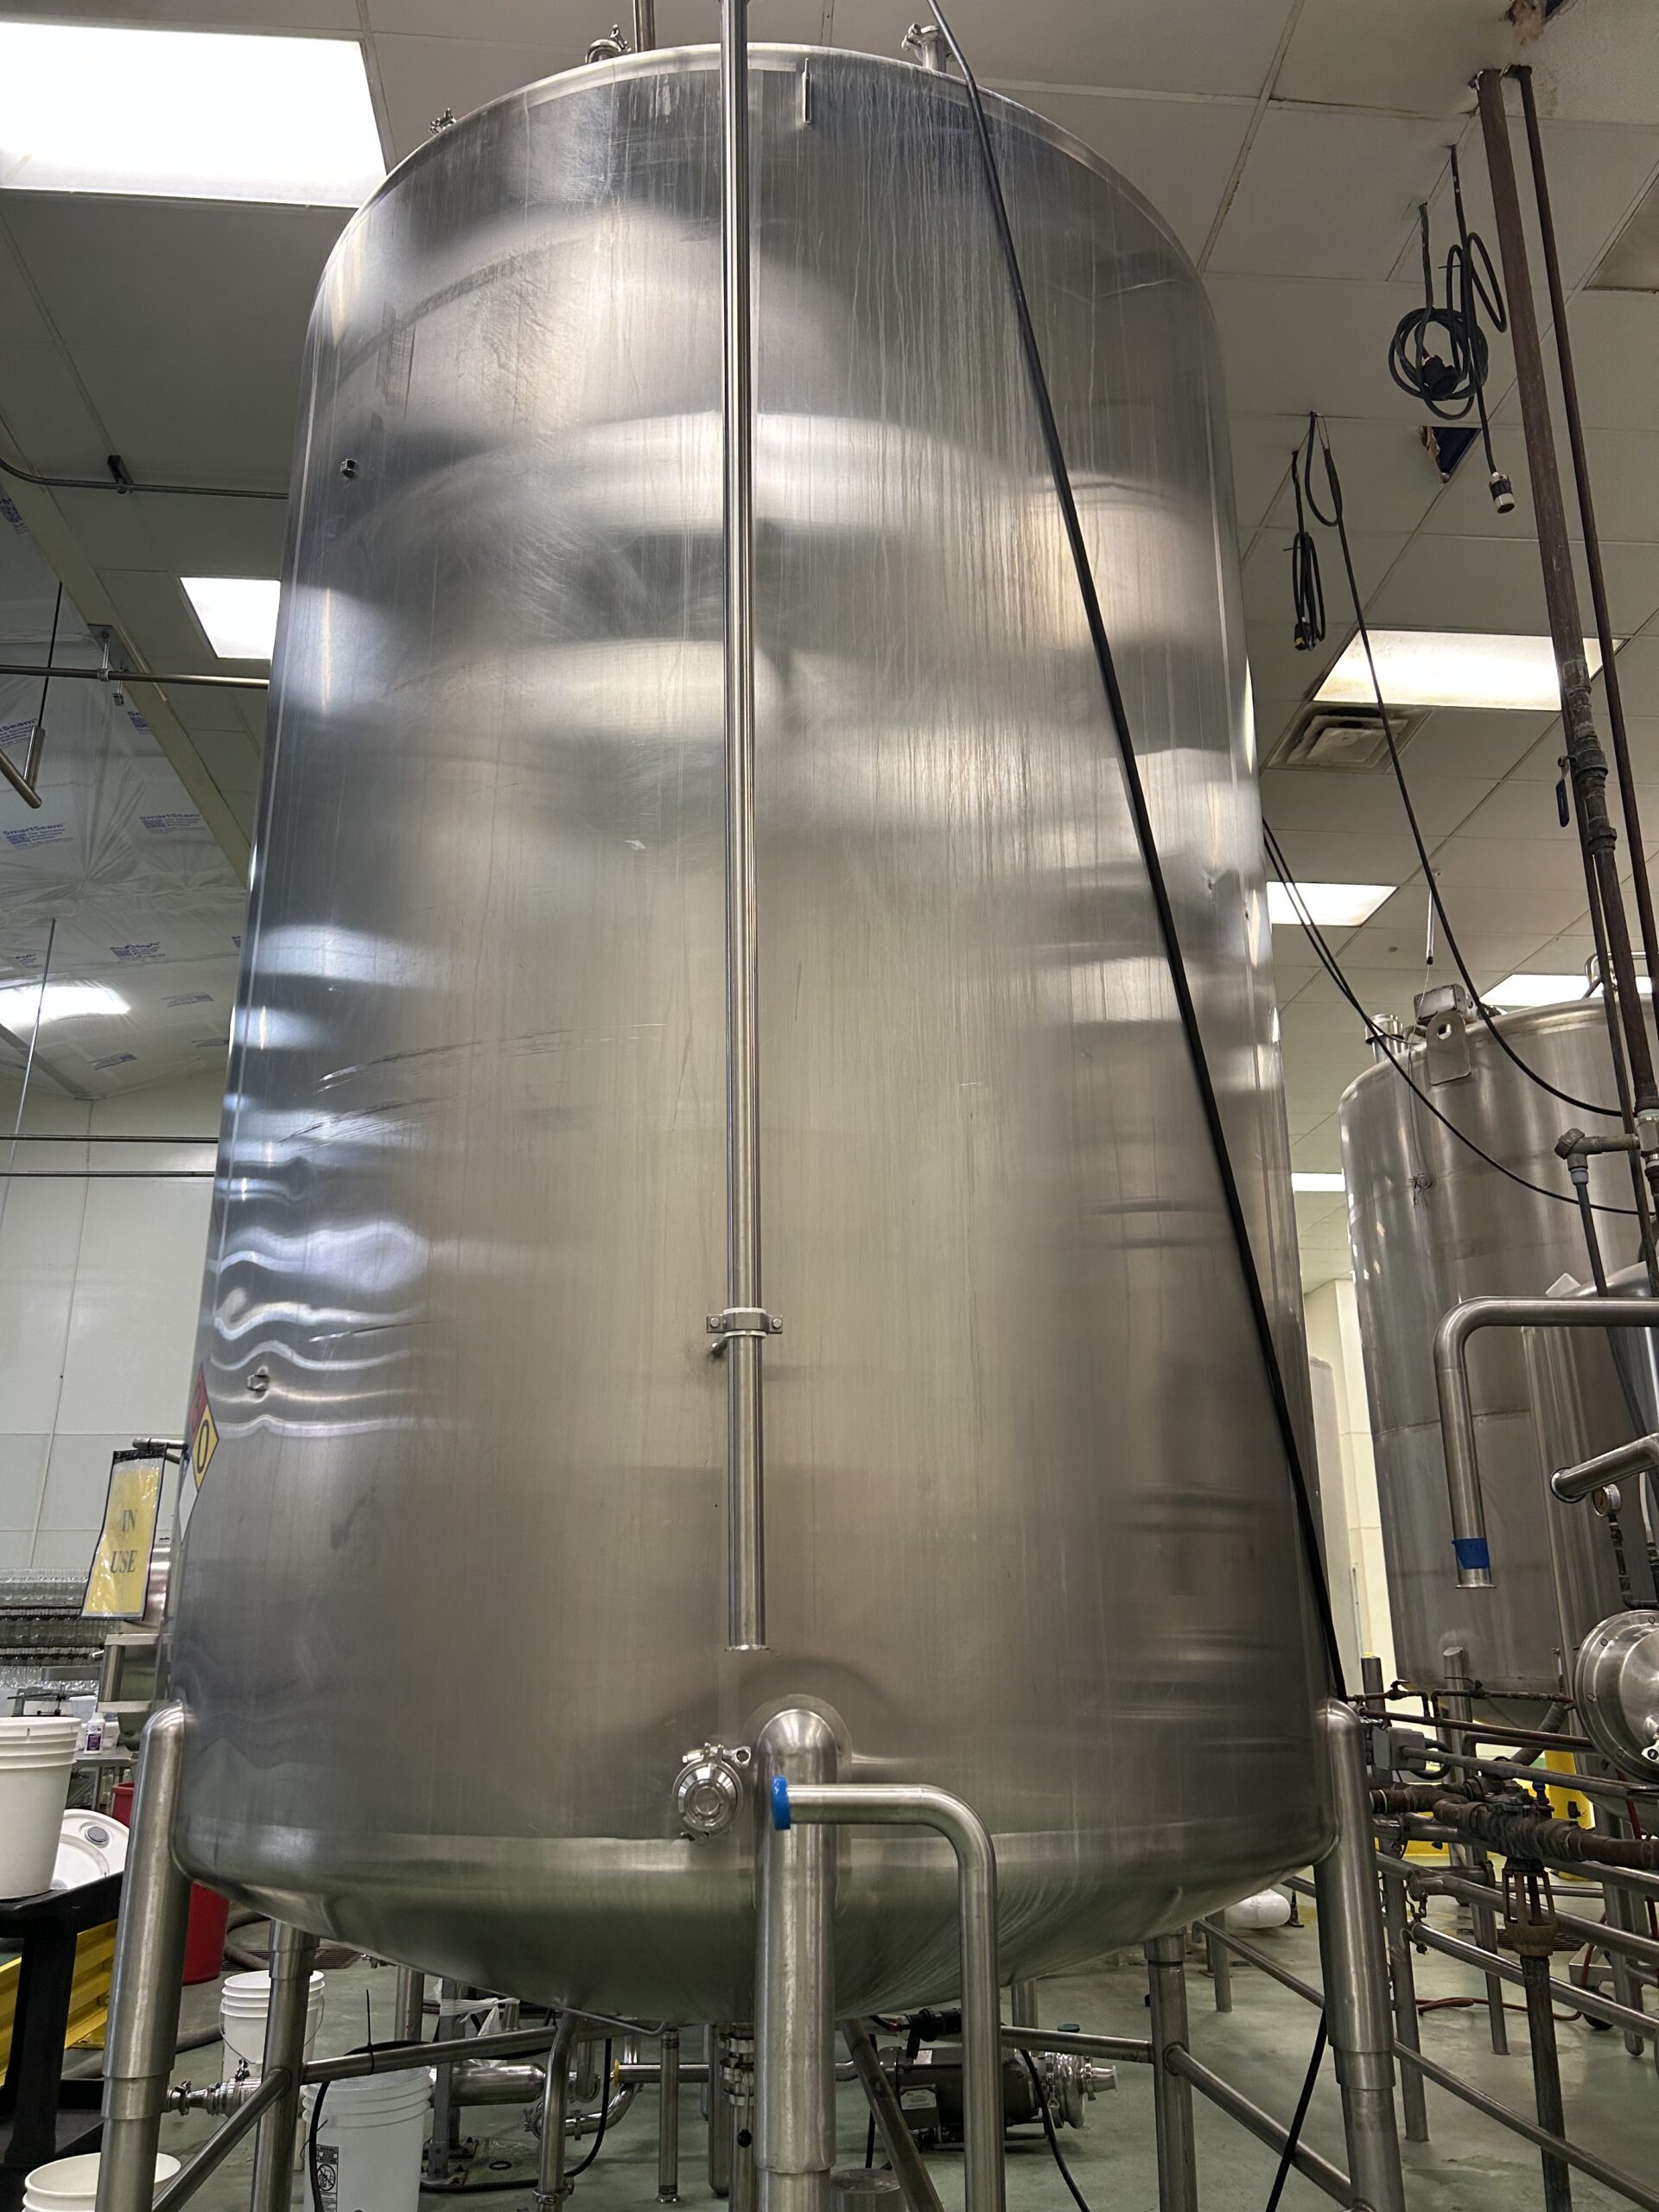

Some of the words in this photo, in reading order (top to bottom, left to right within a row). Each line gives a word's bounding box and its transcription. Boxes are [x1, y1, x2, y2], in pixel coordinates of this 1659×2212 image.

[197, 1420, 209, 1474] 0
[121, 1509, 137, 1532] IN
[111, 1550, 137, 1573] USE
